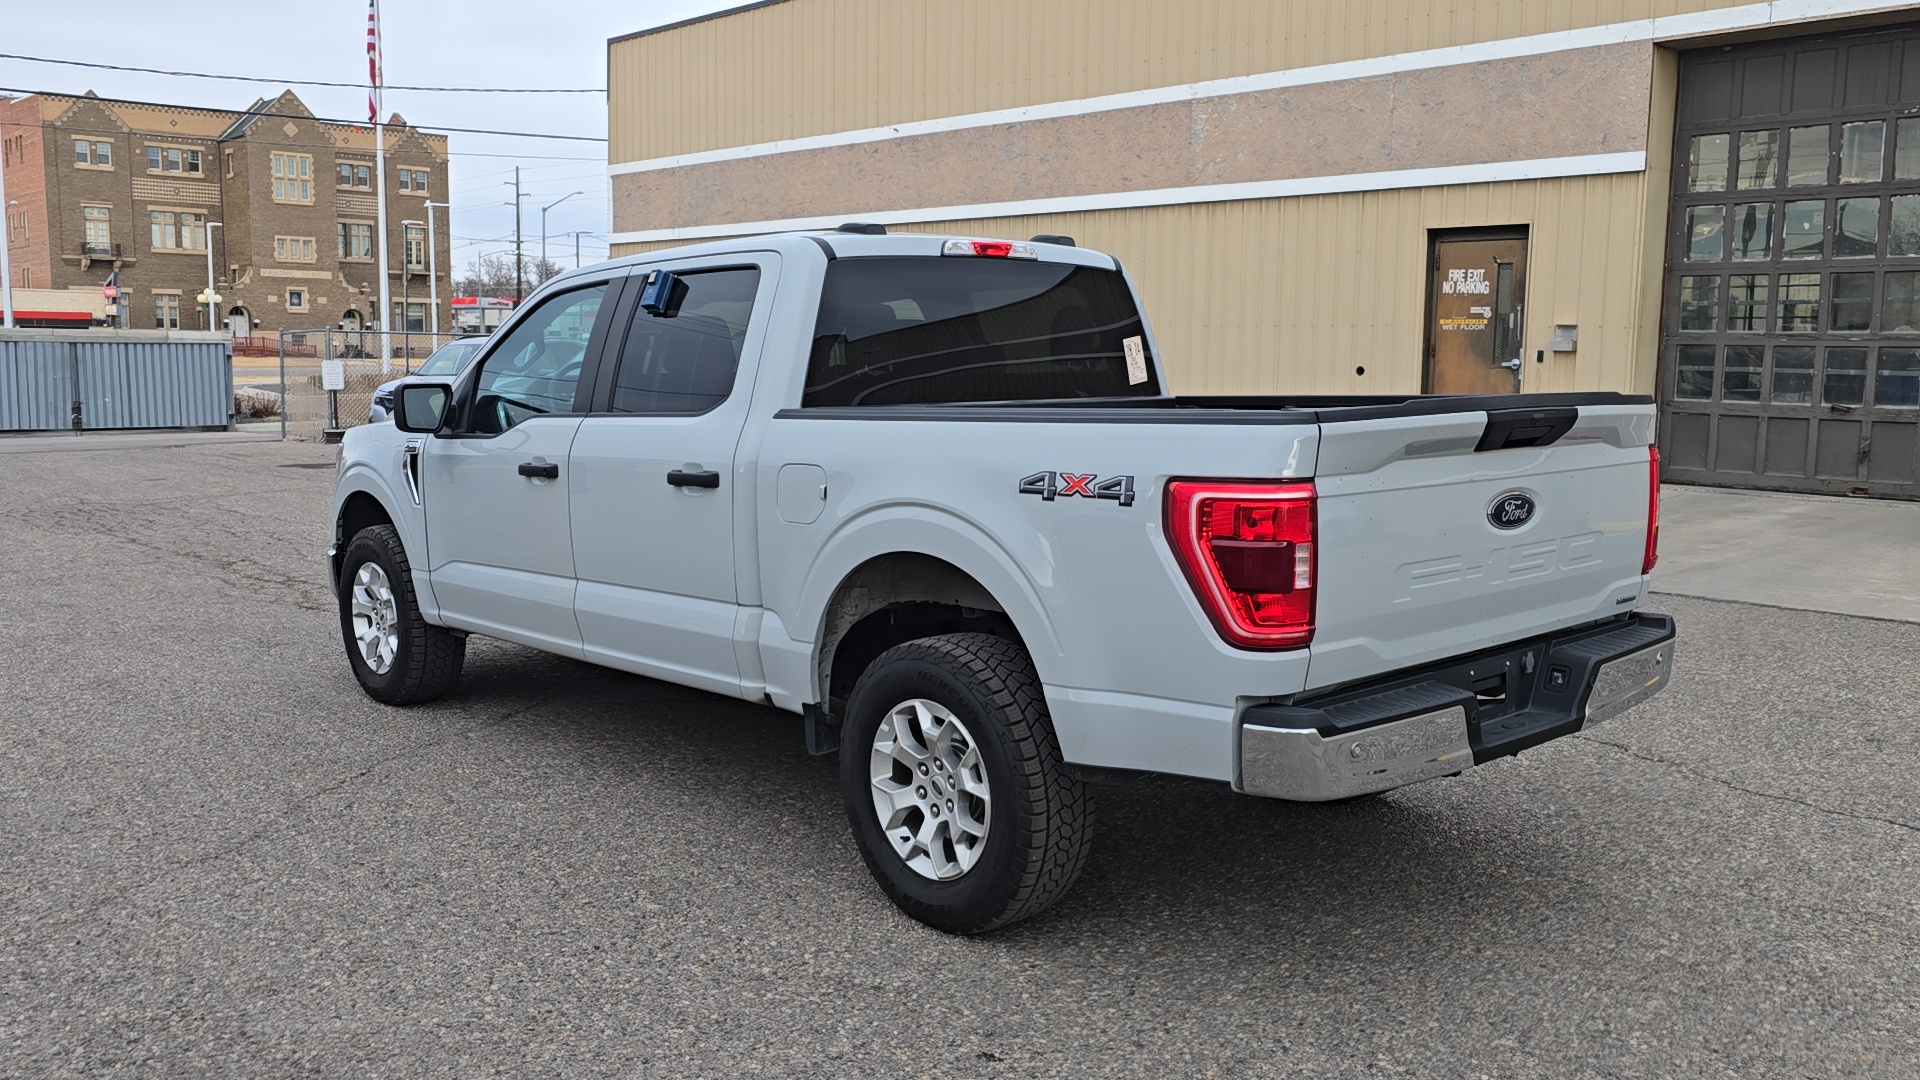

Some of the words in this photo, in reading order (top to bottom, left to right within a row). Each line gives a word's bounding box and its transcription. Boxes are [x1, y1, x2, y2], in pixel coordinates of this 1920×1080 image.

[1448, 269, 1466, 281] FIRE
[1467, 269, 1485, 281] EXIT
[1442, 281, 1454, 294] NO
[1456, 281, 1490, 294] PARKING
[1502, 500, 1529, 522] Ford
[1393, 531, 1604, 603] F-150
